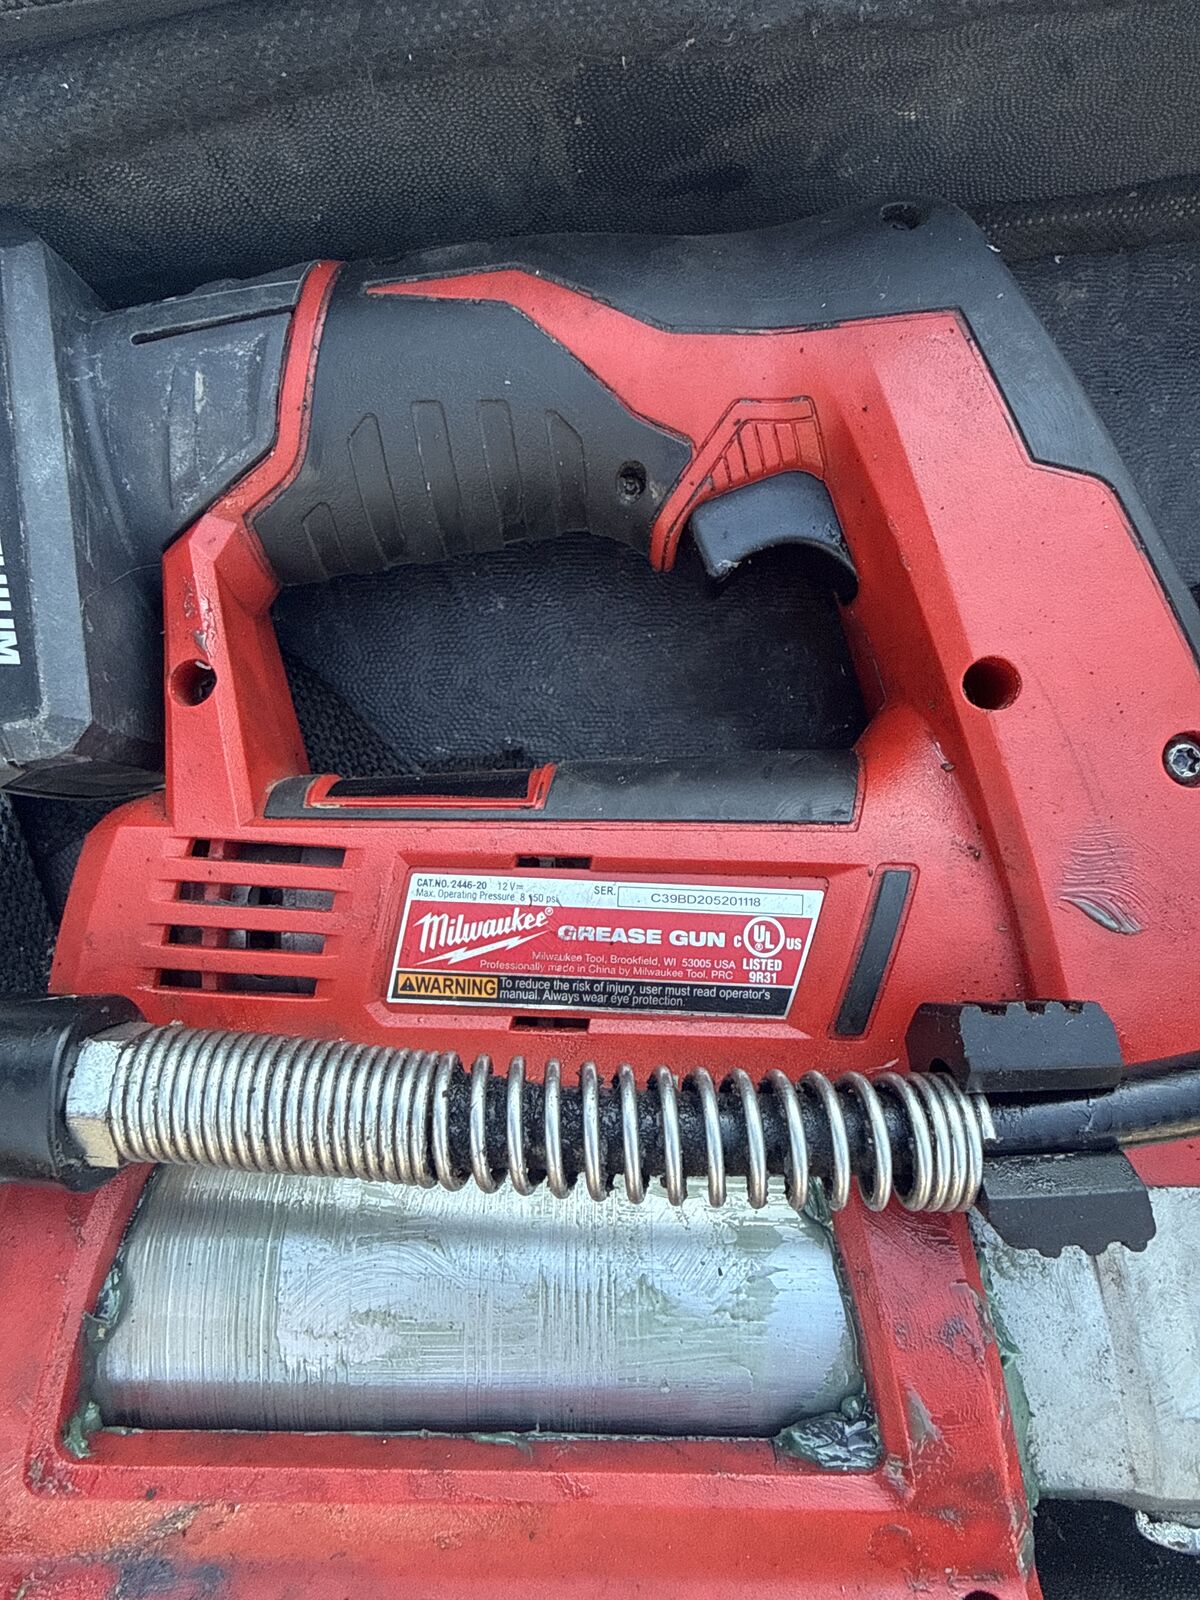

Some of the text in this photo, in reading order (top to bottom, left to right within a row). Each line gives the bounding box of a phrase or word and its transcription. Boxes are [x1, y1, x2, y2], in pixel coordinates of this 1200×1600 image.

[450, 880, 487, 890] 2446-20
[594, 886, 616, 896] SER.
[415, 888, 436, 898] Max.
[437, 889, 477, 901] Operating
[479, 891, 516, 902] Pressure
[651, 893, 761, 908] C39BD205201118
[412, 907, 549, 953] Milwaukee
[557, 925, 726, 948] GREASE GUN
[786, 937, 802, 950] US
[532, 952, 582, 963] Milwaukee
[610, 954, 661, 967] Brookfield,
[664, 957, 677, 967] WI
[682, 958, 711, 969] 53005
[714, 960, 736, 970] USA
[742, 957, 783, 971] LISTED
[479, 960, 545, 972] Professionally
[547, 965, 575, 973] made
[577, 964, 586, 973] in
[588, 964, 616, 974] China
[618, 965, 630, 977] by
[632, 967, 684, 978] Milwaukee
[711, 970, 734, 980] PRC
[748, 971, 777, 984] 9R31
[415, 977, 496, 996] WARNING
[500, 976, 771, 1001] To reduce the risk of injury, user must read operator's
[500, 989, 686, 1007] manual. Always wear eye protection.
